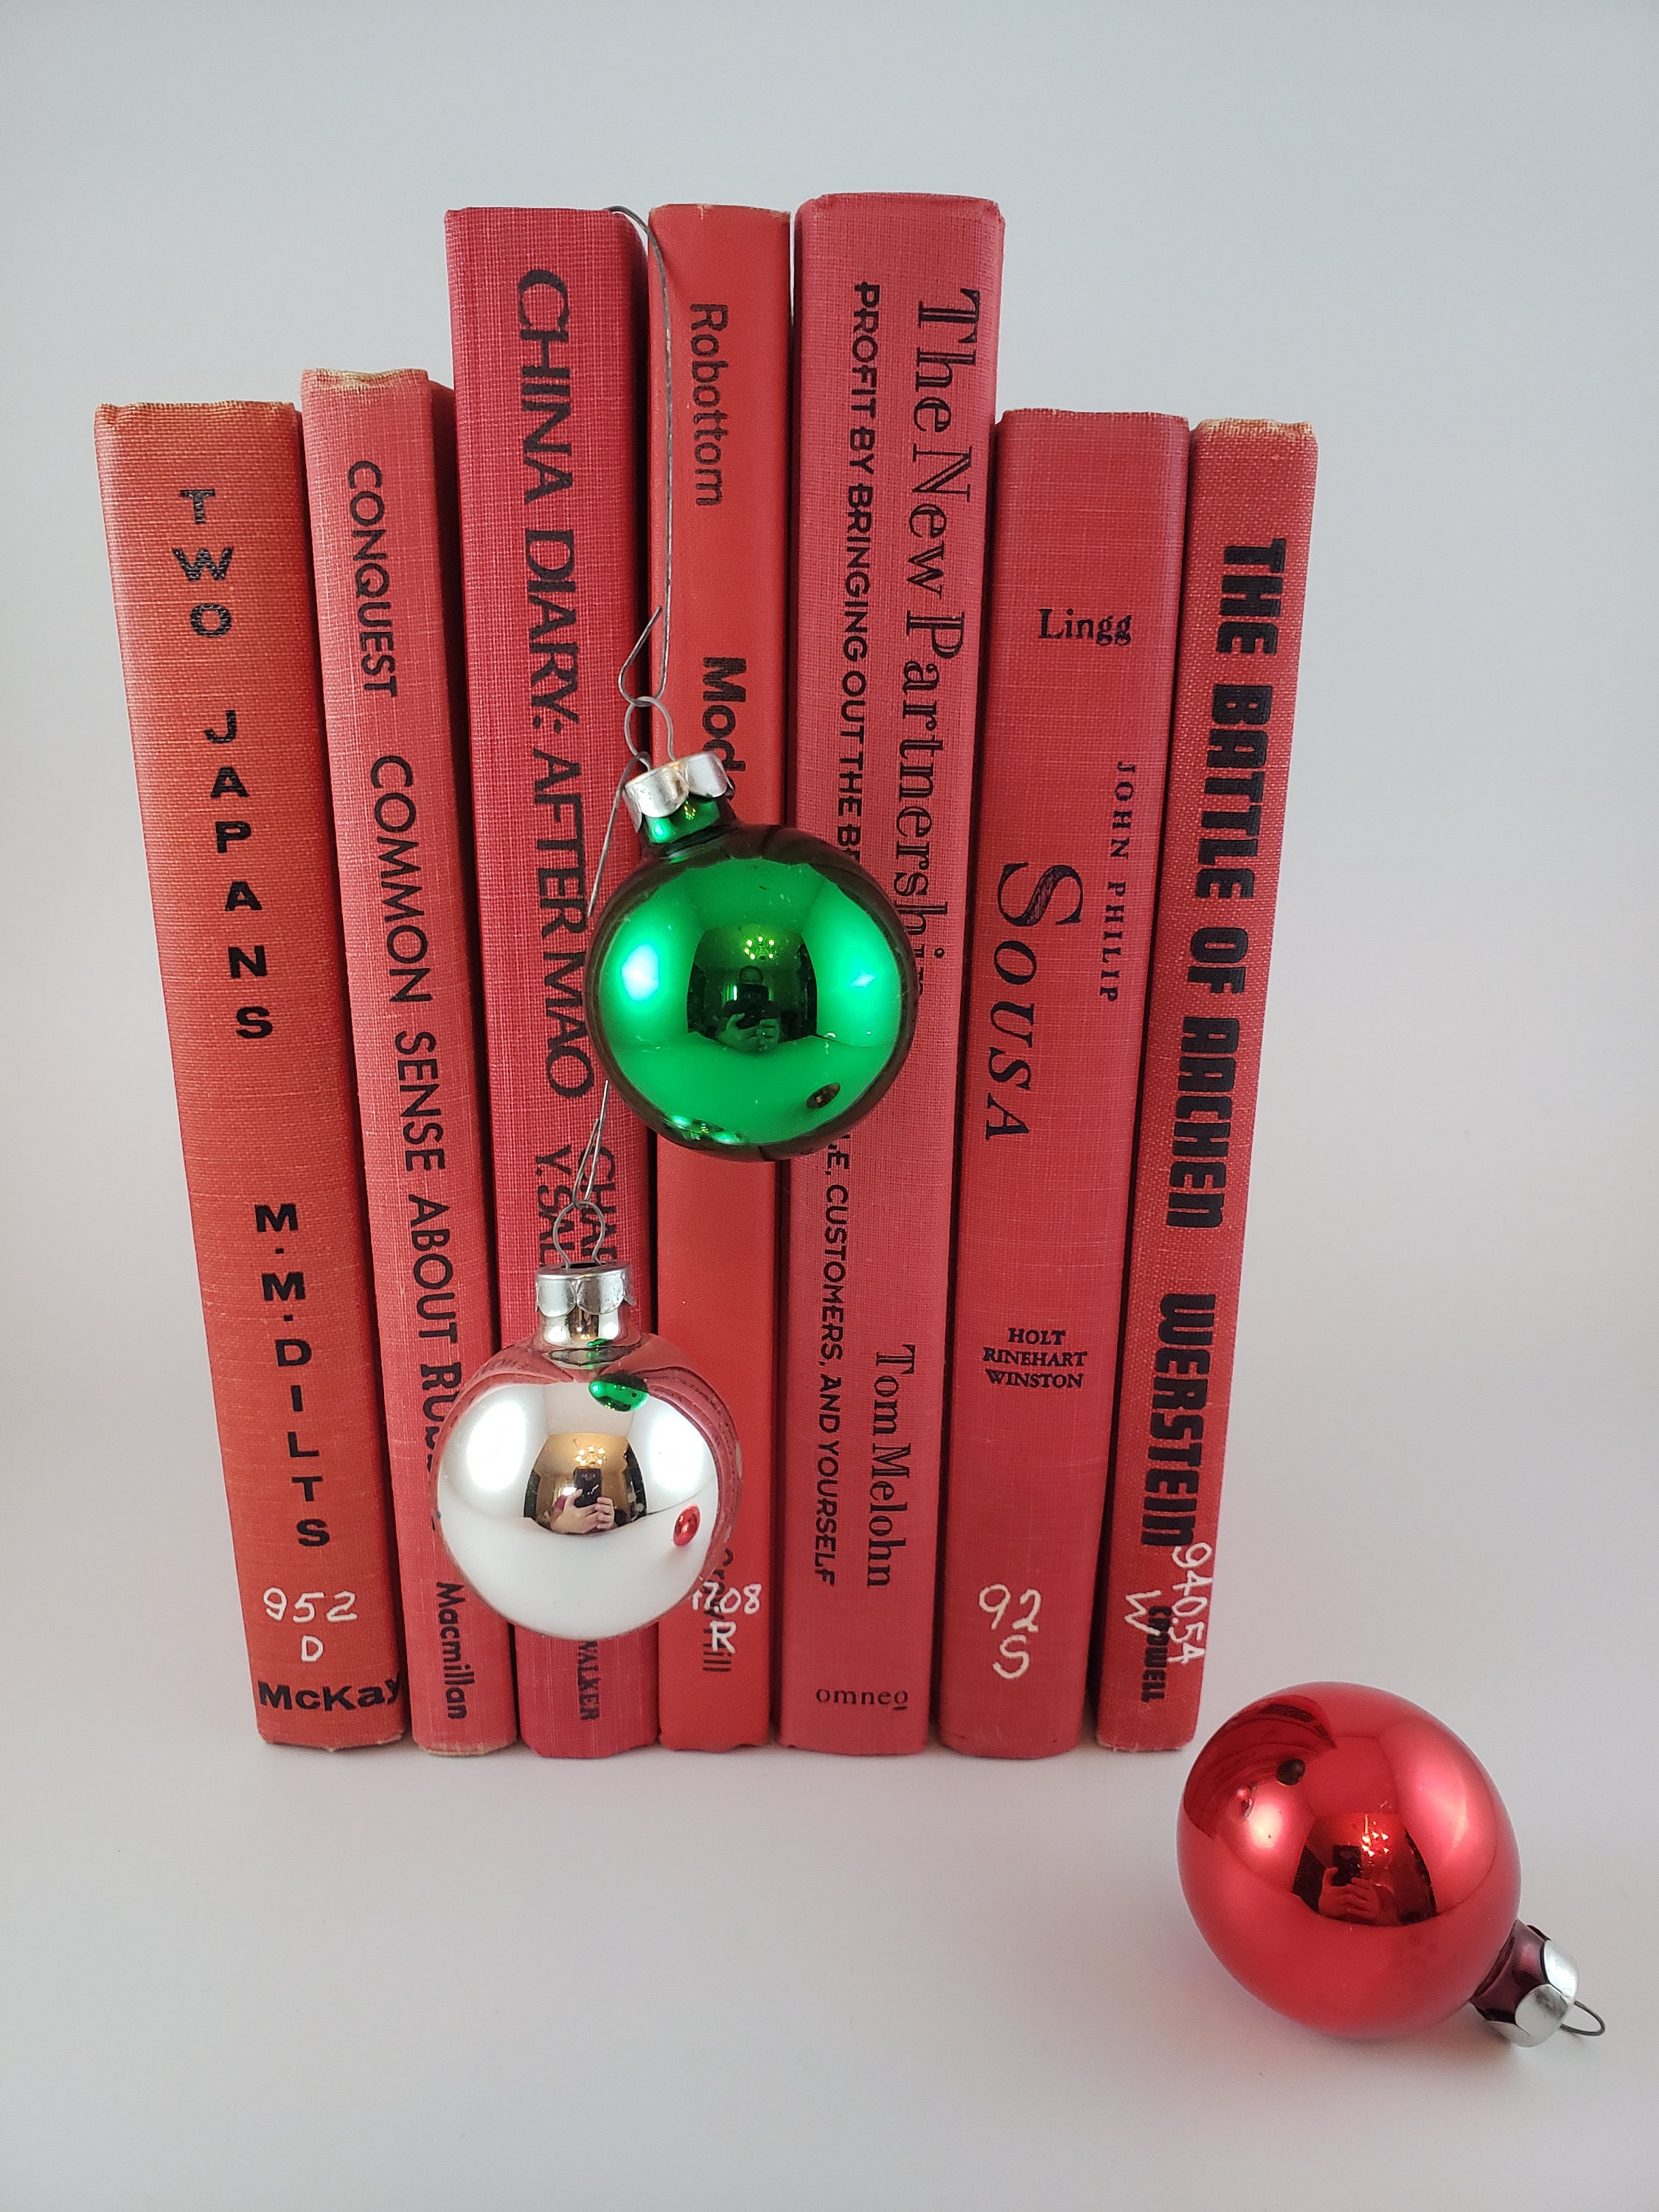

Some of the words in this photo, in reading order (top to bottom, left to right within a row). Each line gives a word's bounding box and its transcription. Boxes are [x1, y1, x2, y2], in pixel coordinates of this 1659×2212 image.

[516, 265, 574, 505] CHINA
[689, 303, 729, 506] Robottom
[851, 281, 880, 420] PROFIT
[913, 287, 981, 433] The
[849, 425, 875, 475] BY
[171, 488, 234, 639] TWO
[347, 460, 398, 698] CONQUEST
[843, 482, 874, 662] BRINGING
[906, 443, 973, 600] New
[524, 528, 580, 734] DIARY:
[1037, 608, 1133, 647] Lingg
[1215, 538, 1287, 655] THE
[701, 656, 747, 802] Mod
[839, 670, 867, 746] OUT
[532, 747, 589, 940] AFTER
[838, 751, 864, 818] THE
[893, 611, 965, 995] Partnershi
[1110, 761, 1136, 860] JOHN
[1194, 683, 1273, 900] BATTLE
[202, 709, 274, 1040] JAPANS
[369, 754, 434, 1003] COMMON
[1099, 881, 1127, 1002] PHILIP
[543, 951, 595, 1099] MAO
[1186, 927, 1249, 994] OF
[394, 1030, 446, 1172] SENSE
[1166, 1015, 1240, 1228] AACHEN
[408, 1194, 458, 1344] ABOUT
[818, 1184, 849, 1366] CUSTOMERS,
[1008, 1327, 1066, 1346] HOLT
[818, 1373, 842, 1433] AND
[872, 1344, 916, 1436] Tom
[982, 1346, 1088, 1367] RINEHART
[984, 1368, 1084, 1389] WINSTON
[1140, 1293, 1217, 1548] WERSTEIN
[814, 1440, 840, 1586] YOURSELF
[866, 1442, 911, 1587] Melohn
[263, 1587, 358, 1623] 952
[301, 1635, 324, 1662] D
[436, 1582, 476, 1719] Macmillan
[709, 1620, 737, 1653] R
[979, 1584, 1041, 1632] 92
[1124, 1590, 1161, 1636] W
[1166, 1542, 1214, 1665] 940.54
[257, 1674, 400, 1712] McKay
[815, 1689, 908, 1711] omneo
